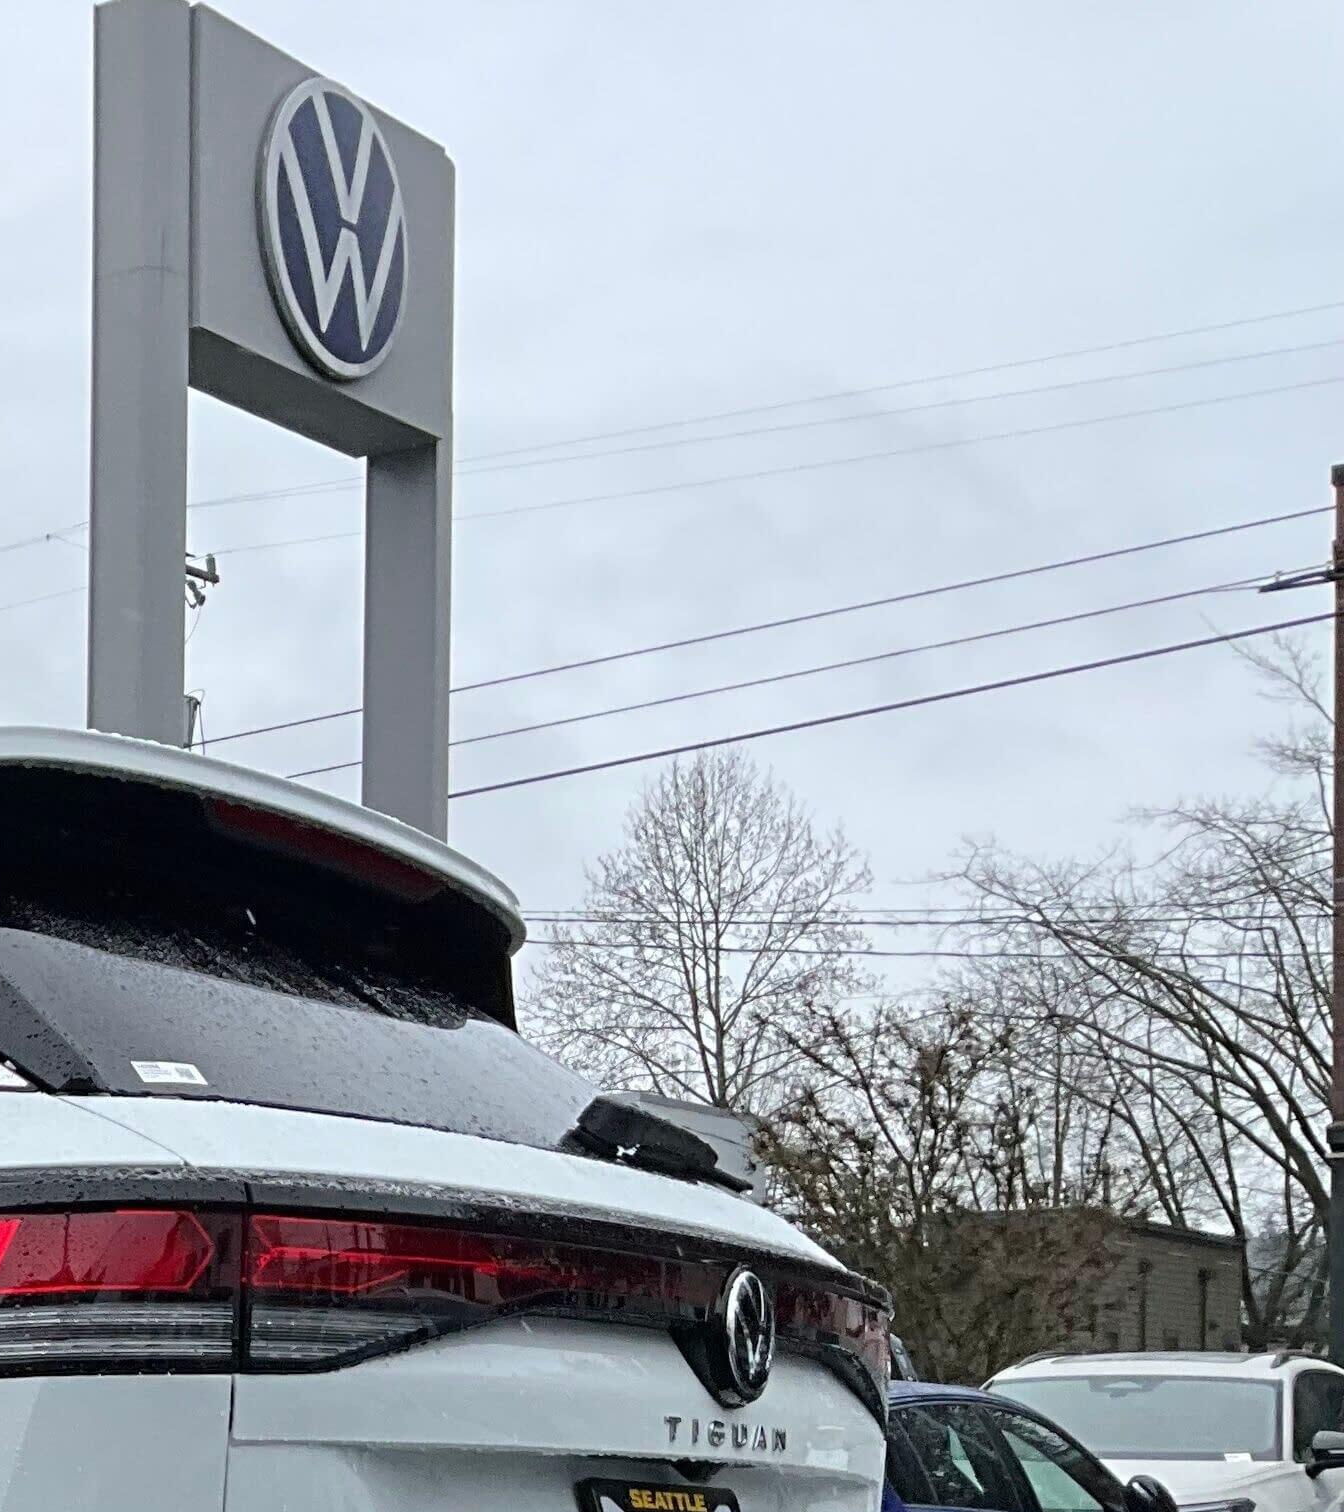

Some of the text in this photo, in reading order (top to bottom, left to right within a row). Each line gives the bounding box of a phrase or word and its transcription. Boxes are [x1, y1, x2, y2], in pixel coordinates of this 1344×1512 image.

[266, 76, 409, 377] VW
[664, 1416, 787, 1452] TIGUAN
[628, 1487, 708, 1512] SEATTLE
